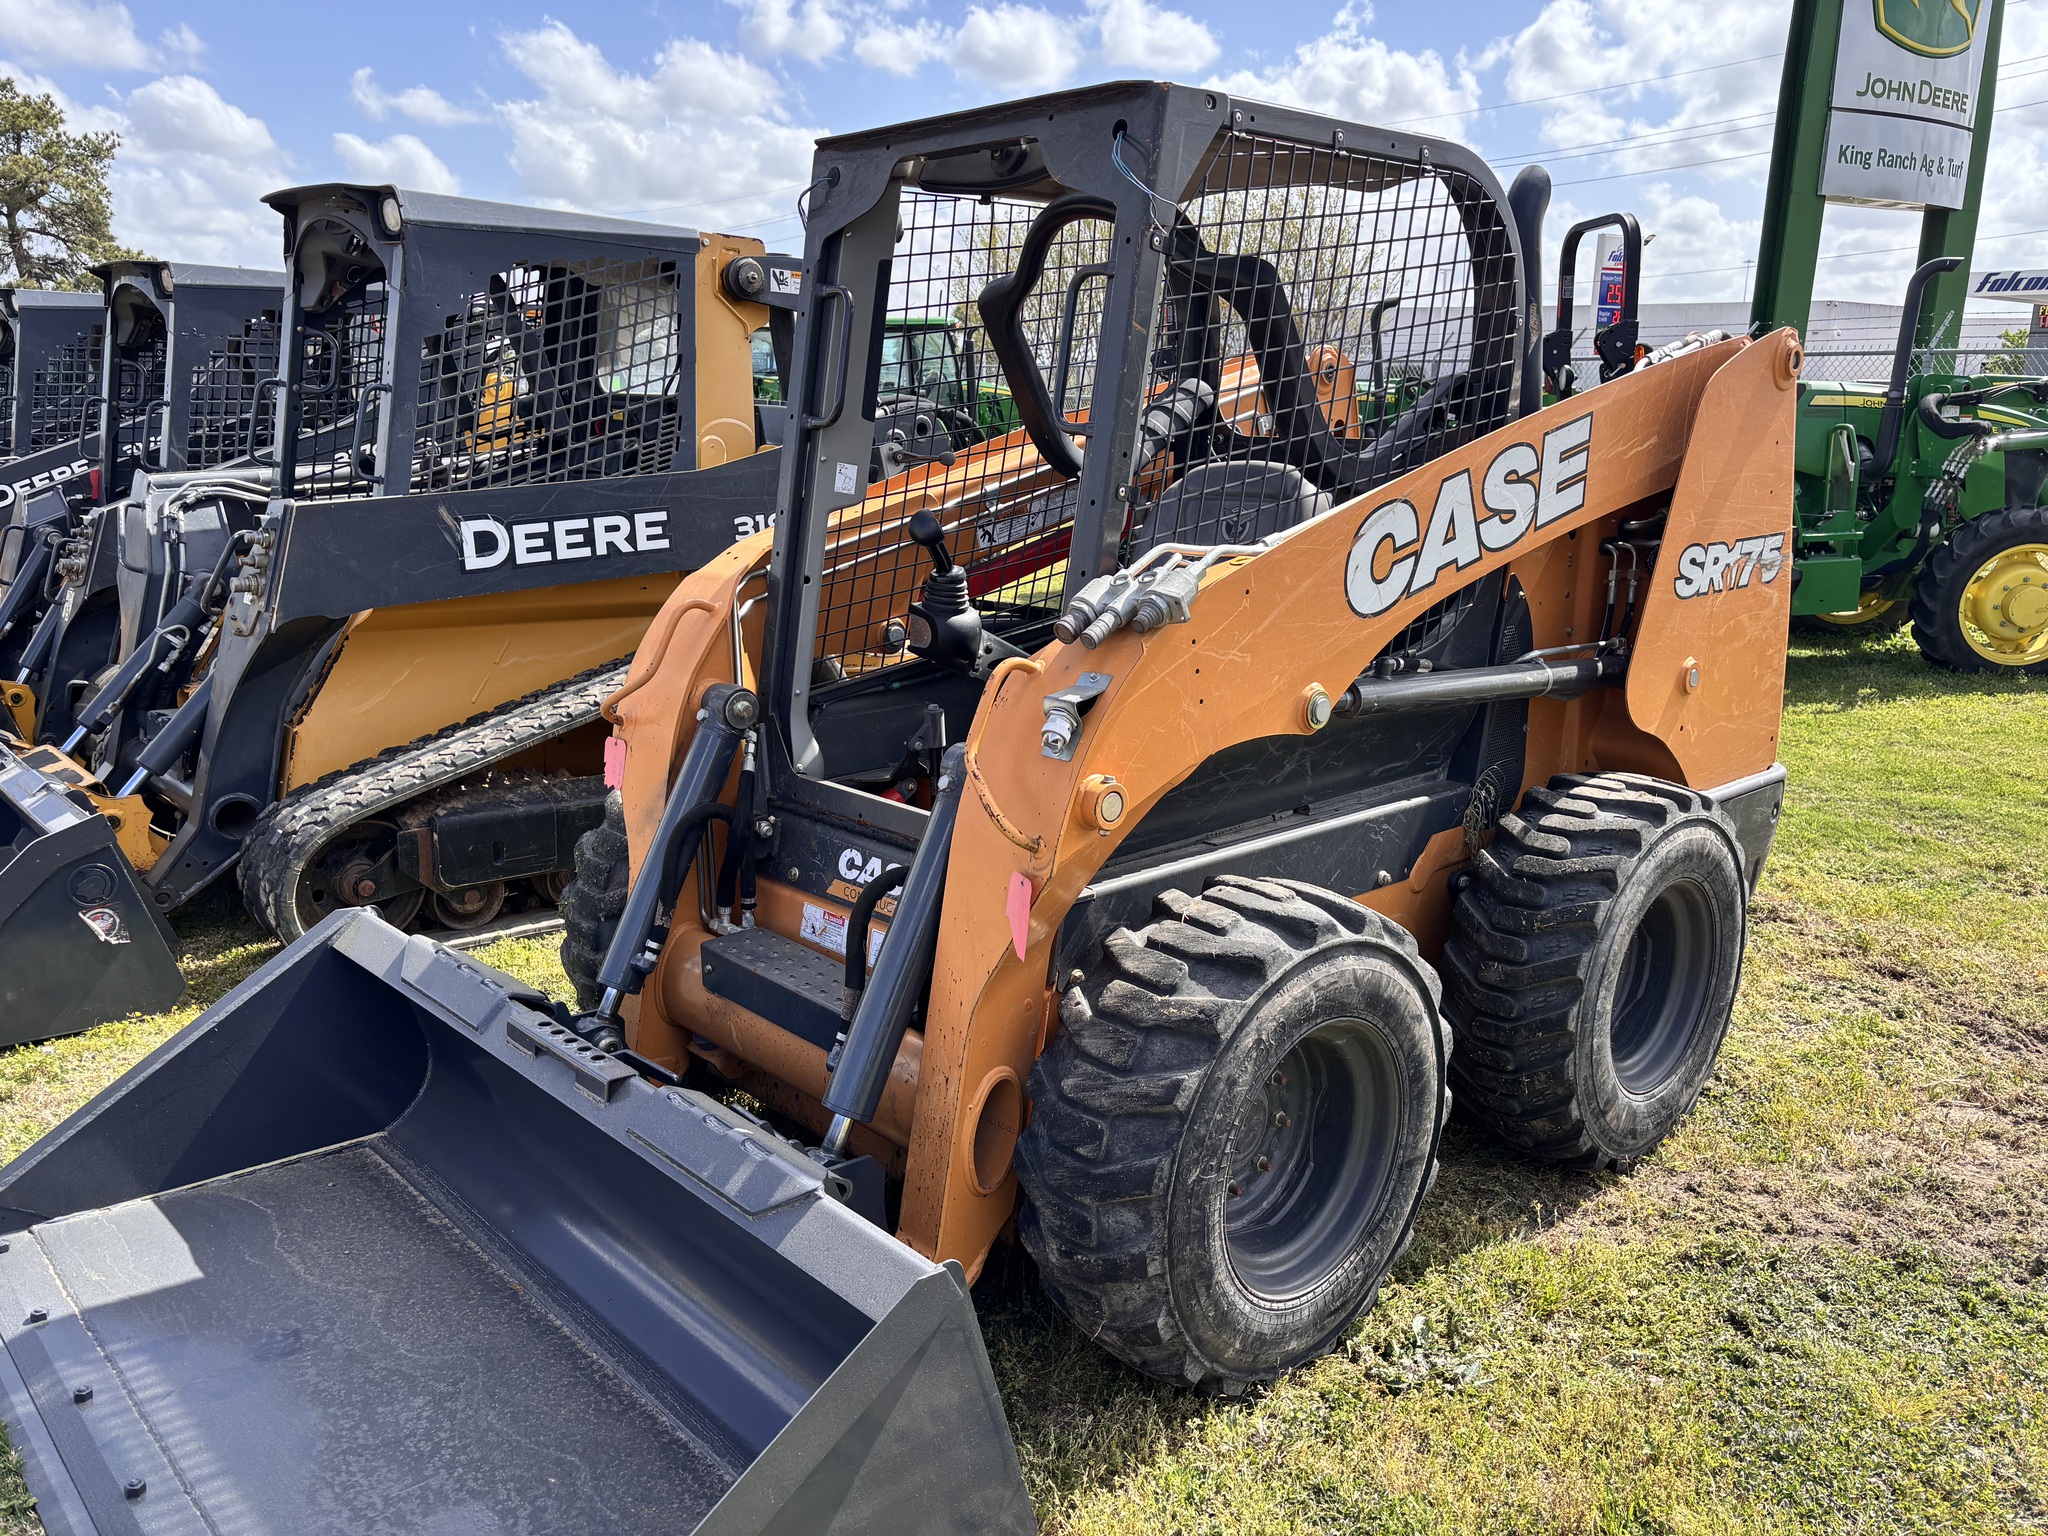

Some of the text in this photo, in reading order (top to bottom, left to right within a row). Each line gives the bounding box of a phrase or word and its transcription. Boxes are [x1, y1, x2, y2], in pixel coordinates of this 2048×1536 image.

[1856, 72, 1969, 114] JOHN DEERE
[1837, 144, 1964, 178] King Ranch Ag & Turf
[460, 511, 671, 570] DEERE
[1344, 411, 1594, 618] CASE
[1674, 532, 1785, 599] SR175
